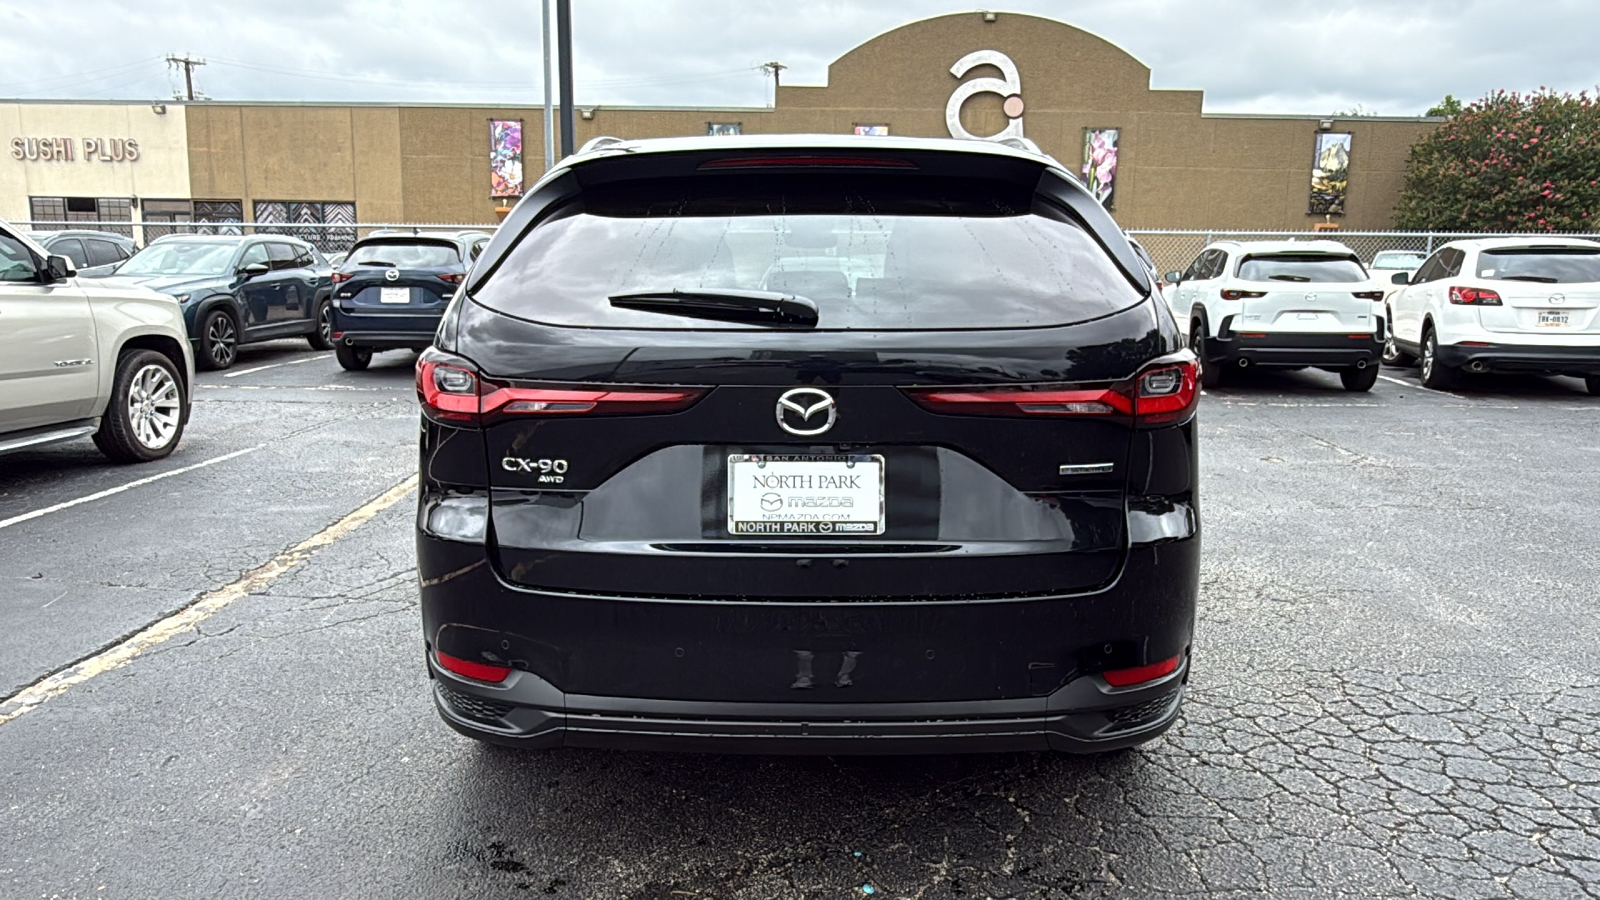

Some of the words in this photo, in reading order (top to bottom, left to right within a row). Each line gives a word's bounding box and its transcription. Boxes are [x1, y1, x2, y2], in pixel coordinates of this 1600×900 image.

[11, 137, 74, 161] SUSHI
[82, 137, 140, 162] PLUS
[502, 457, 568, 474] CX-90
[537, 475, 564, 484] AWD
[753, 473, 813, 489] NORTH
[819, 475, 861, 489] PARK
[788, 496, 854, 508] mazda
[762, 513, 850, 521] NPMAZDACOM
[738, 522, 780, 532] NORTH
[784, 522, 816, 532] PARK
[835, 523, 874, 531] mazda
